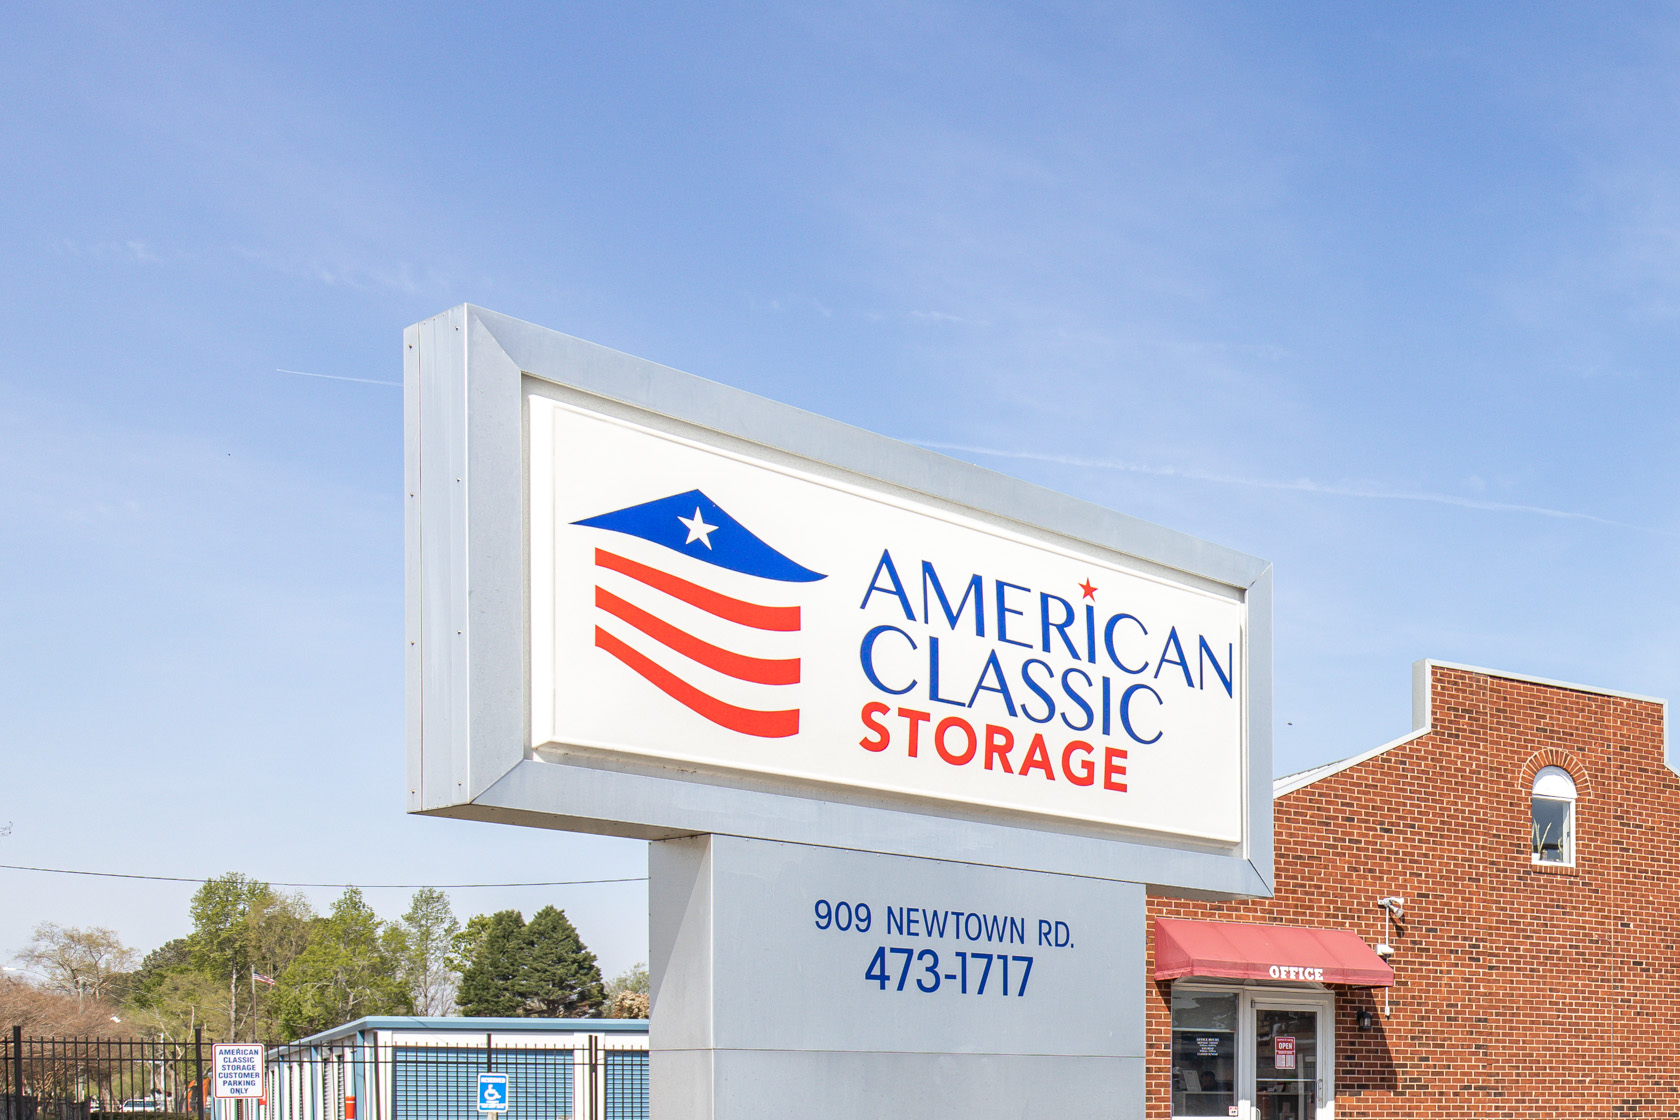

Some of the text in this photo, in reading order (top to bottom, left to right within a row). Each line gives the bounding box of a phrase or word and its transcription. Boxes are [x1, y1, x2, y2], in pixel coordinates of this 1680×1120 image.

[860, 548, 1233, 699] AMERICAN
[860, 624, 1164, 745] CLASSIC
[859, 701, 1128, 793] STORAGE
[814, 899, 1075, 948] 909 NEWTOWN RD.
[864, 946, 1034, 997] 473-1717
[1269, 965, 1324, 981] OFFICE
[1278, 1042, 1293, 1050] OPEN
